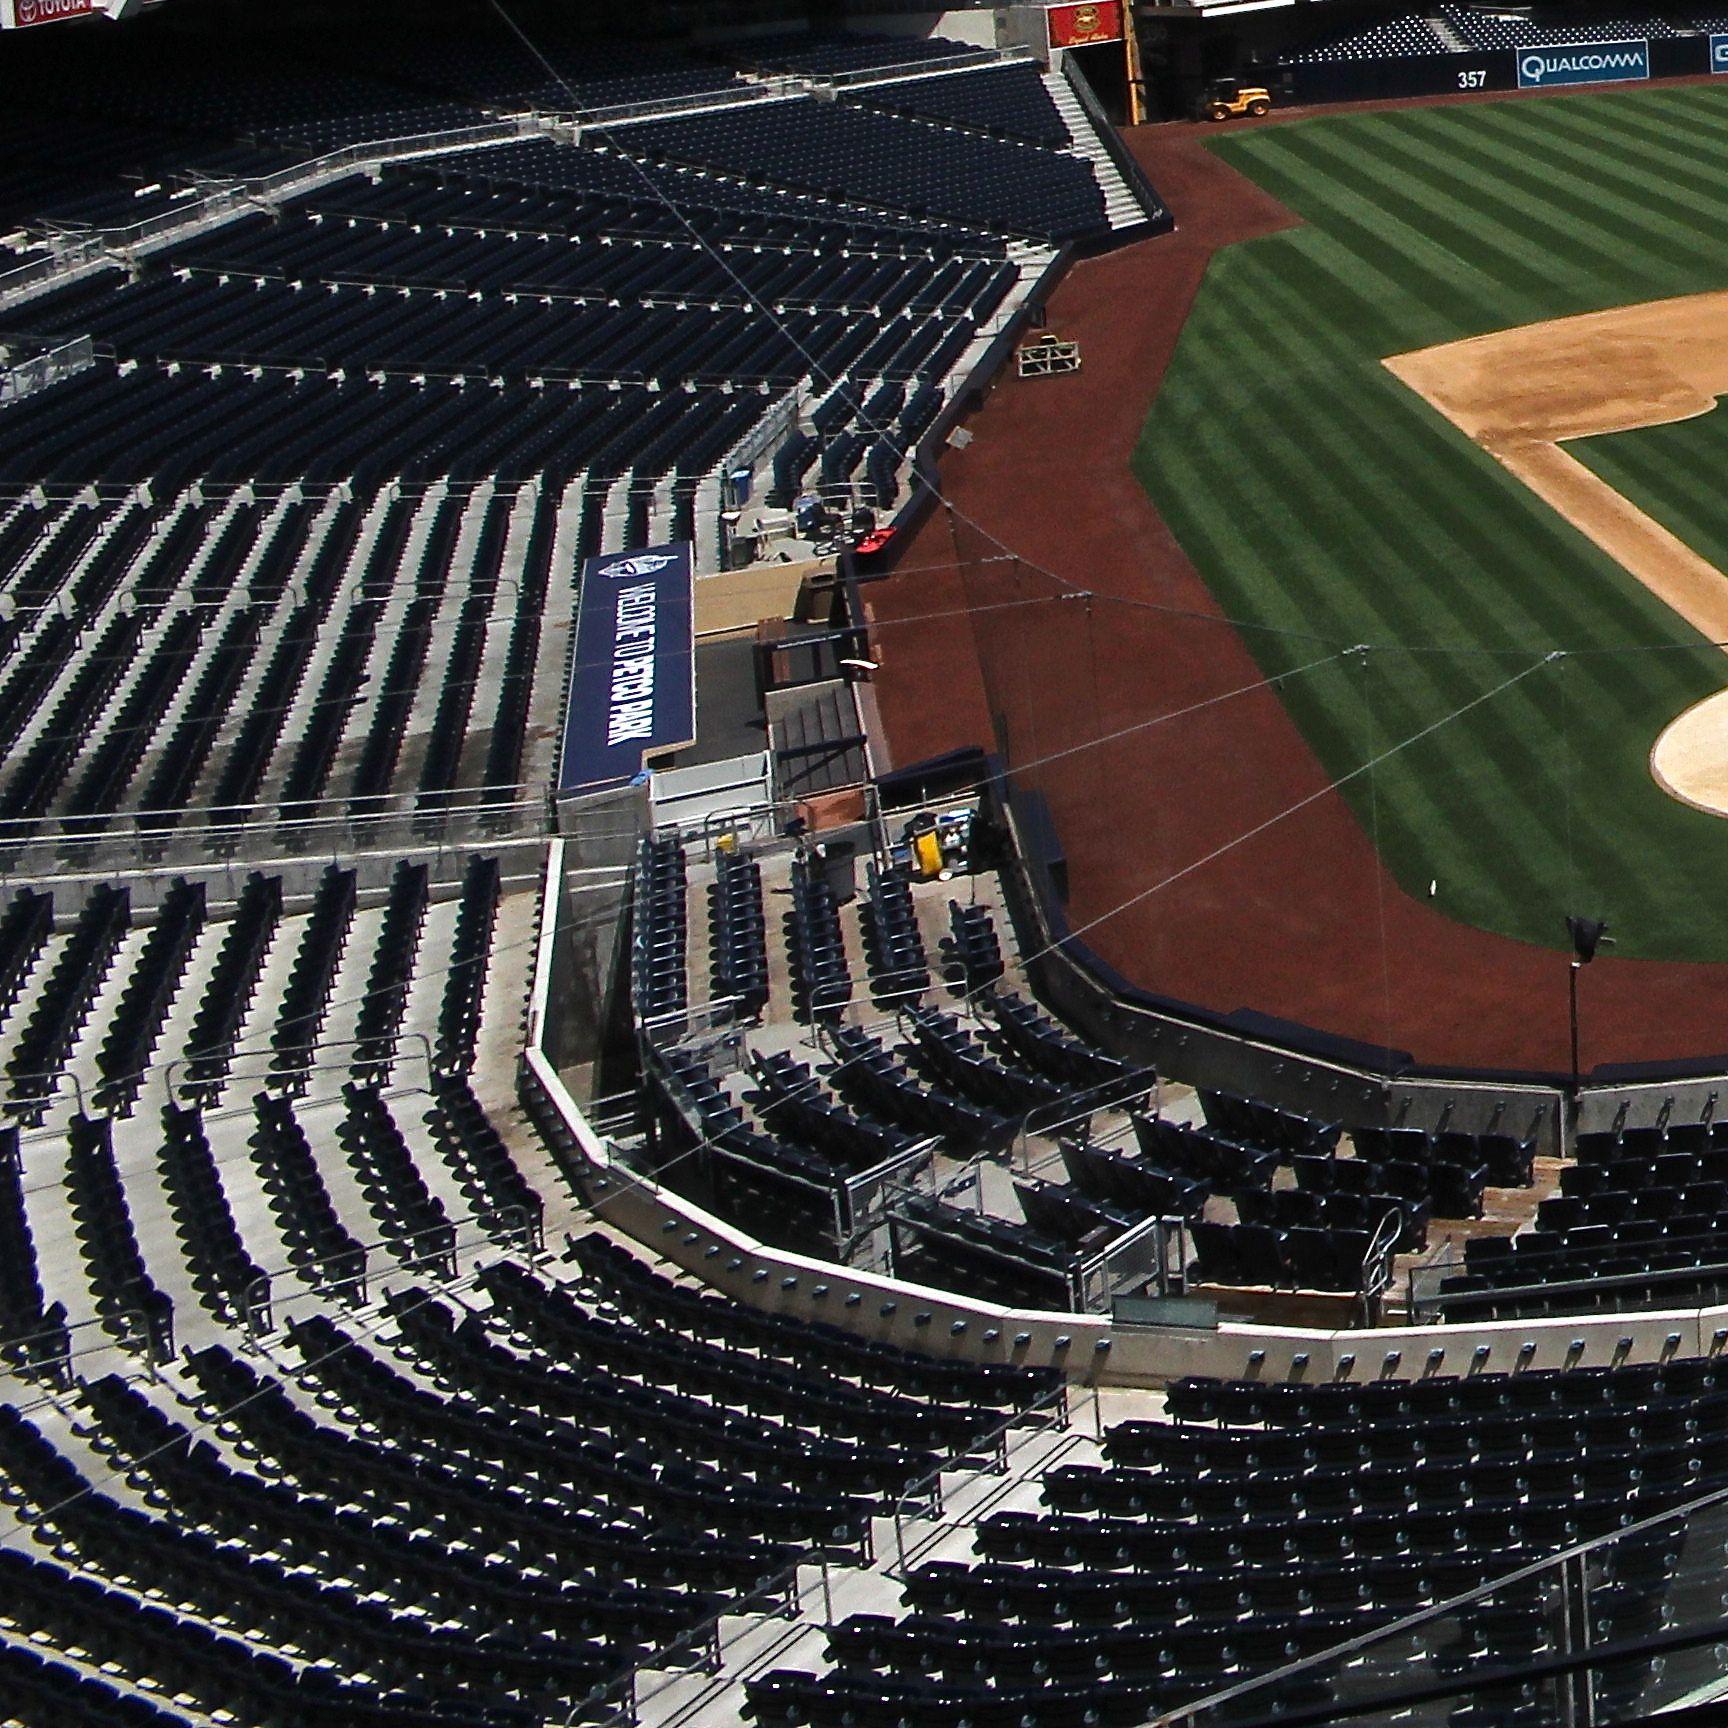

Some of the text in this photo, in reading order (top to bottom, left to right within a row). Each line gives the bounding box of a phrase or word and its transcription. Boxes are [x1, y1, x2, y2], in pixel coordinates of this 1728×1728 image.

[1458, 71, 1487, 88] 357
[1521, 53, 1644, 82] QUALCOMM
[607, 582, 656, 747] WELCOME TO PETCO PARK
